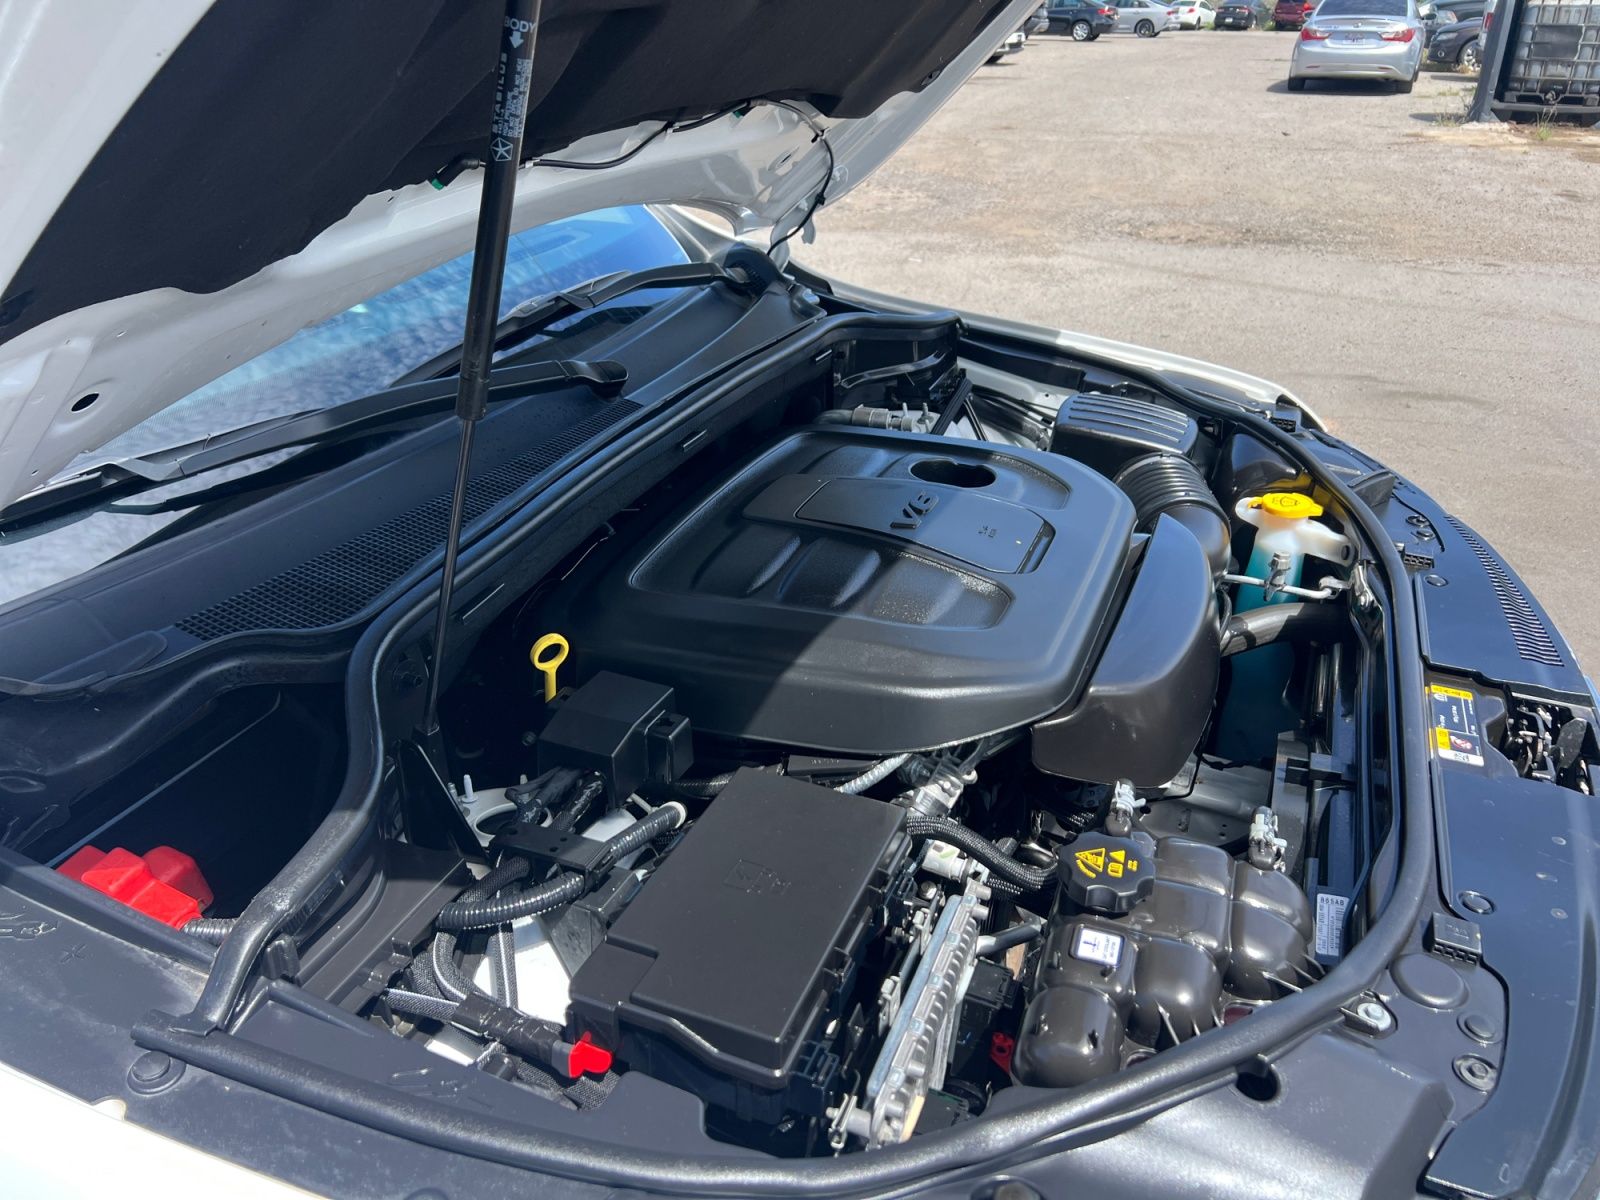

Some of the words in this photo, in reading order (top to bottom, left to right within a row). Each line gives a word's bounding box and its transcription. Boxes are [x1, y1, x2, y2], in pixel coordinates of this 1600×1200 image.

[504, 17, 536, 33] BODY
[491, 53, 508, 133] STABILUS
[889, 490, 939, 530] V6
